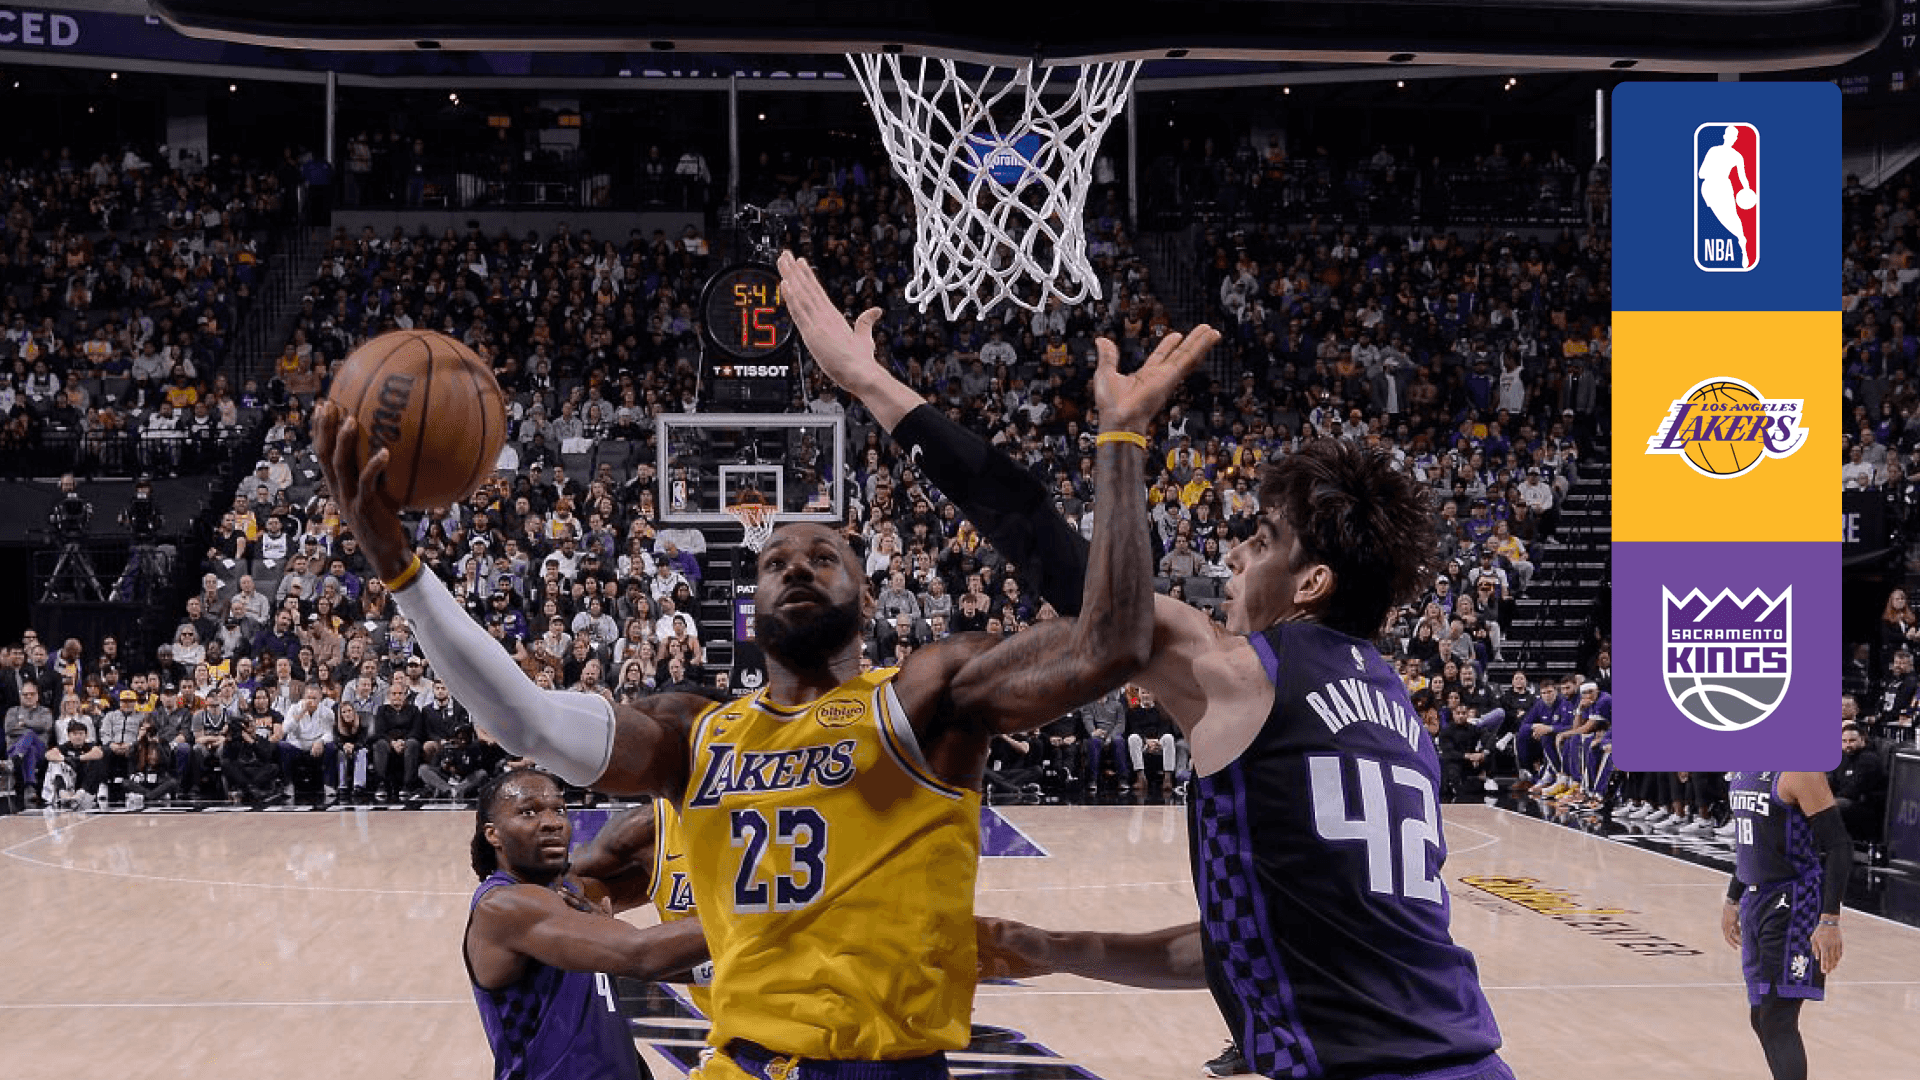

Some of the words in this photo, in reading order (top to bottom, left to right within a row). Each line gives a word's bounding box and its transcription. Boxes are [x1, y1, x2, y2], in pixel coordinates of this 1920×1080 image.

[1902, 35, 1916, 48] 17
[742, 307, 776, 348] 15
[734, 366, 789, 377] TISSOT
[1306, 678, 1420, 752] RAYNAUD
[689, 739, 857, 809] LAKERS
[1308, 756, 1443, 905] 42
[1737, 817, 1753, 845] 18
[730, 806, 829, 914] 23
